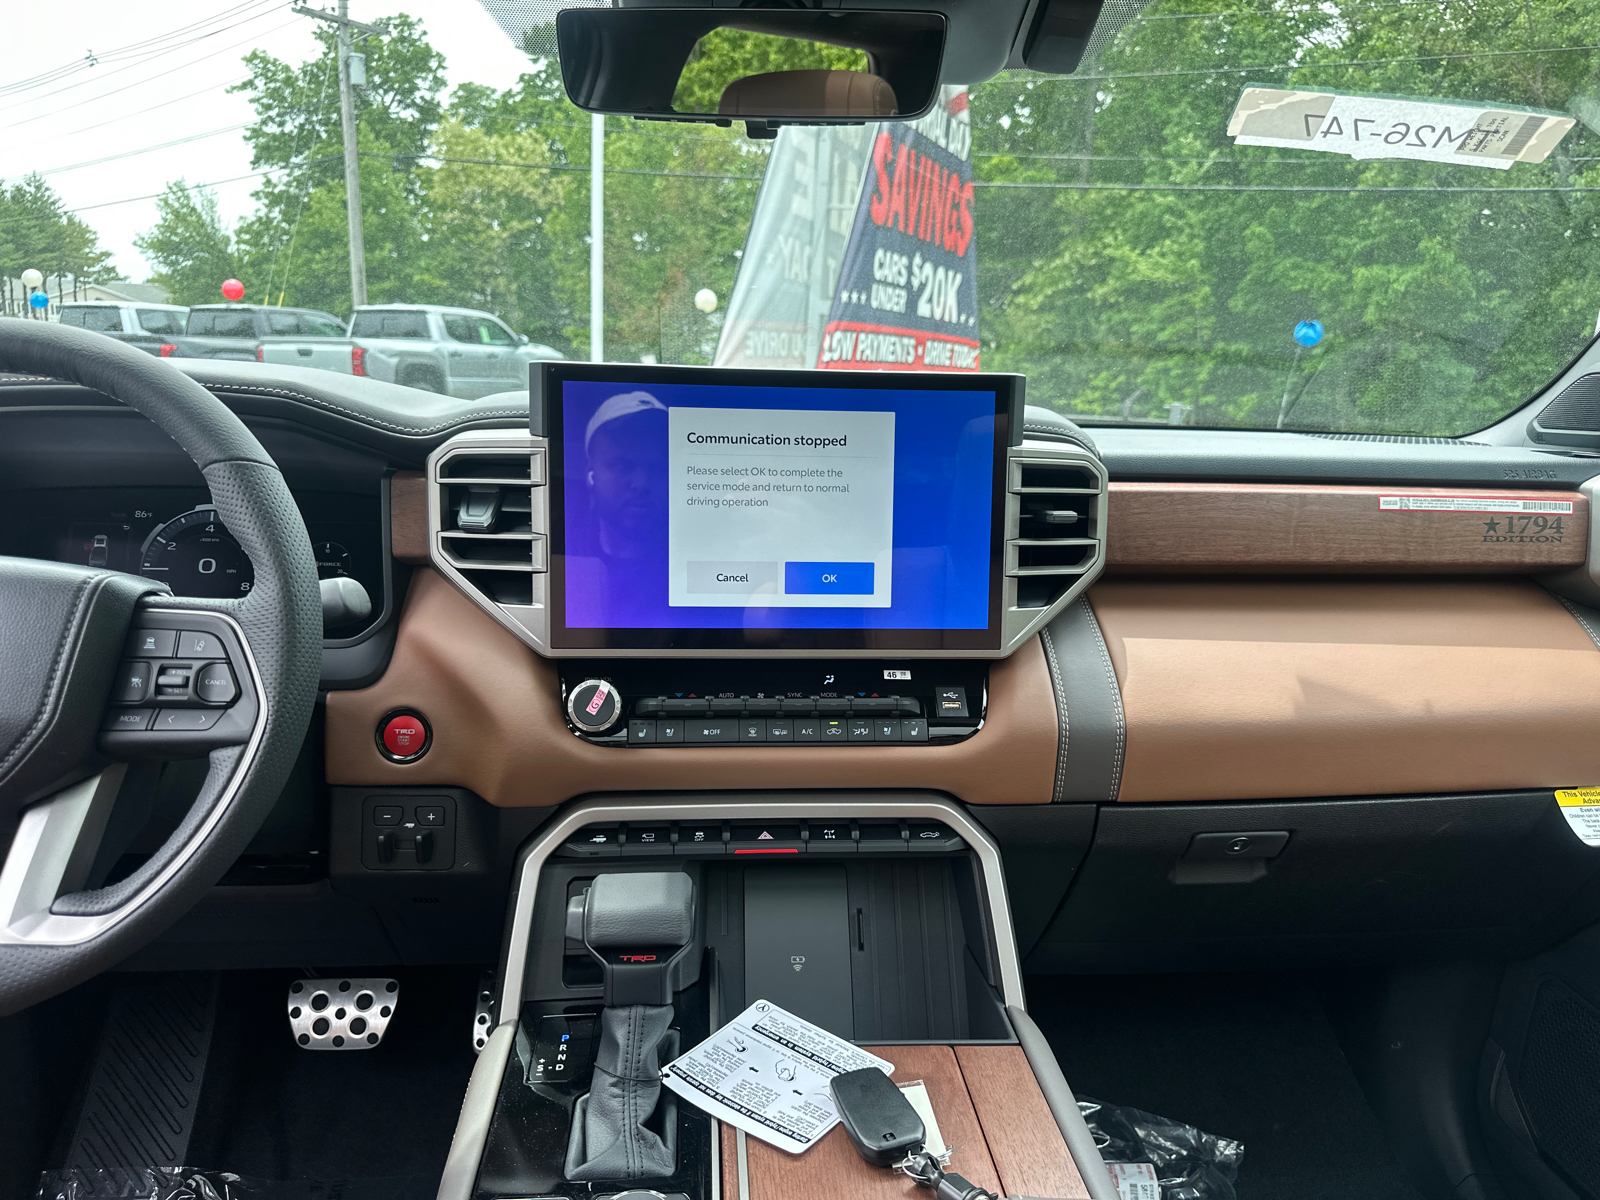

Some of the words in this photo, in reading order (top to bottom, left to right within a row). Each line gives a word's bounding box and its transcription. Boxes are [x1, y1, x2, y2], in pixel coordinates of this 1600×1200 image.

[870, 132, 975, 257] SAVINGS
[873, 248, 908, 286] CARS
[912, 251, 962, 324] $20K
[870, 282, 907, 313] UNDER
[822, 329, 857, 363] LOW
[855, 331, 916, 364] PAYMENTS
[687, 432, 790, 445] Communication
[793, 435, 847, 448] stopped
[687, 466, 719, 476] Please
[721, 466, 748, 476] select
[750, 467, 766, 477] OK
[768, 468, 778, 477] to
[780, 468, 825, 478] complete
[827, 469, 843, 477] the
[687, 482, 720, 491] service
[722, 482, 750, 491] mode
[752, 482, 770, 492] and
[772, 483, 802, 492] return
[803, 484, 814, 492] to
[815, 483, 850, 493] normal
[687, 497, 720, 508] driving
[722, 497, 768, 508] operation
[205, 524, 215, 532] 4
[1505, 516, 1564, 534] 1794
[1482, 535, 1563, 543] EDITION
[167, 541, 176, 550] 2
[716, 573, 749, 583] Cancel
[822, 574, 837, 583] OK
[241, 582, 250, 591] 8
[561, 1034, 569, 1042] P
